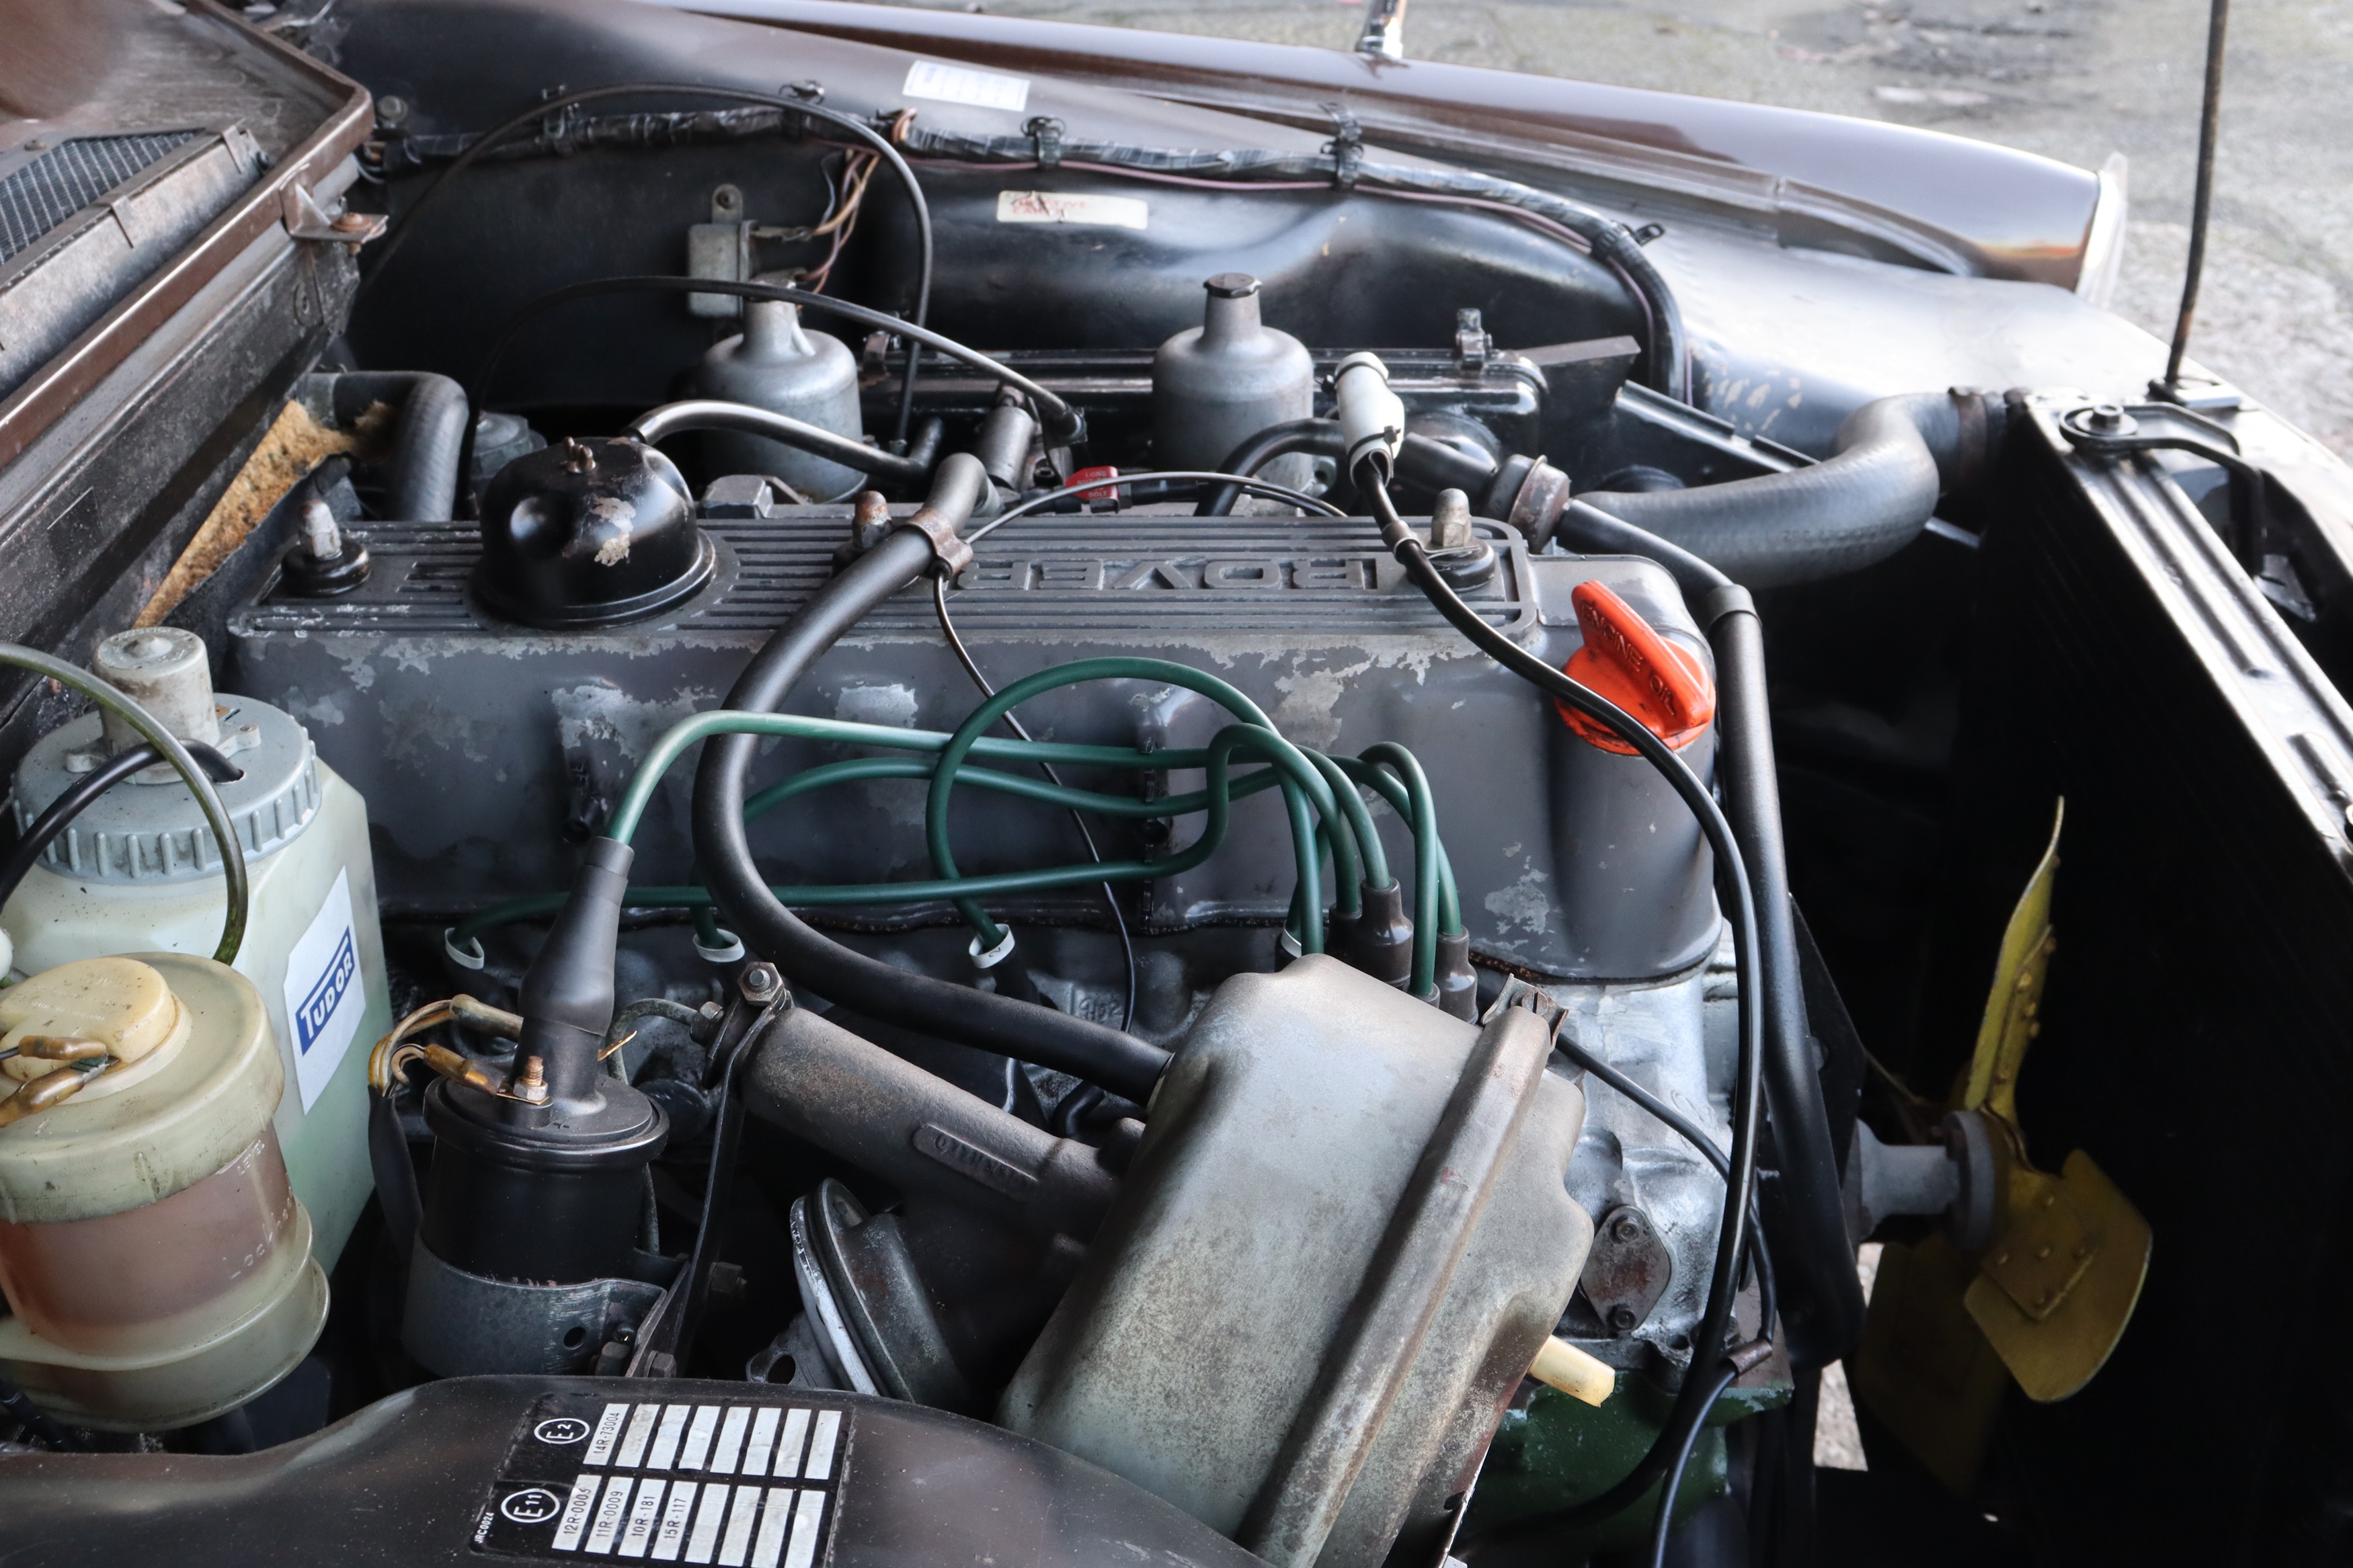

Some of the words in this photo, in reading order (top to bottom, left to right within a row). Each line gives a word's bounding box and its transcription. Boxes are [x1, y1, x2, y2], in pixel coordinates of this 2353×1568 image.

[957, 559, 1366, 591] ROVER
[1581, 600, 1643, 672] ENGINE
[1650, 674, 1675, 715] OIL
[300, 936, 353, 1040] TUDOR
[594, 1413, 620, 1454] 14R-73004
[474, 1512, 495, 1544] JRC0024
[596, 1491, 623, 1538] 11R-0009
